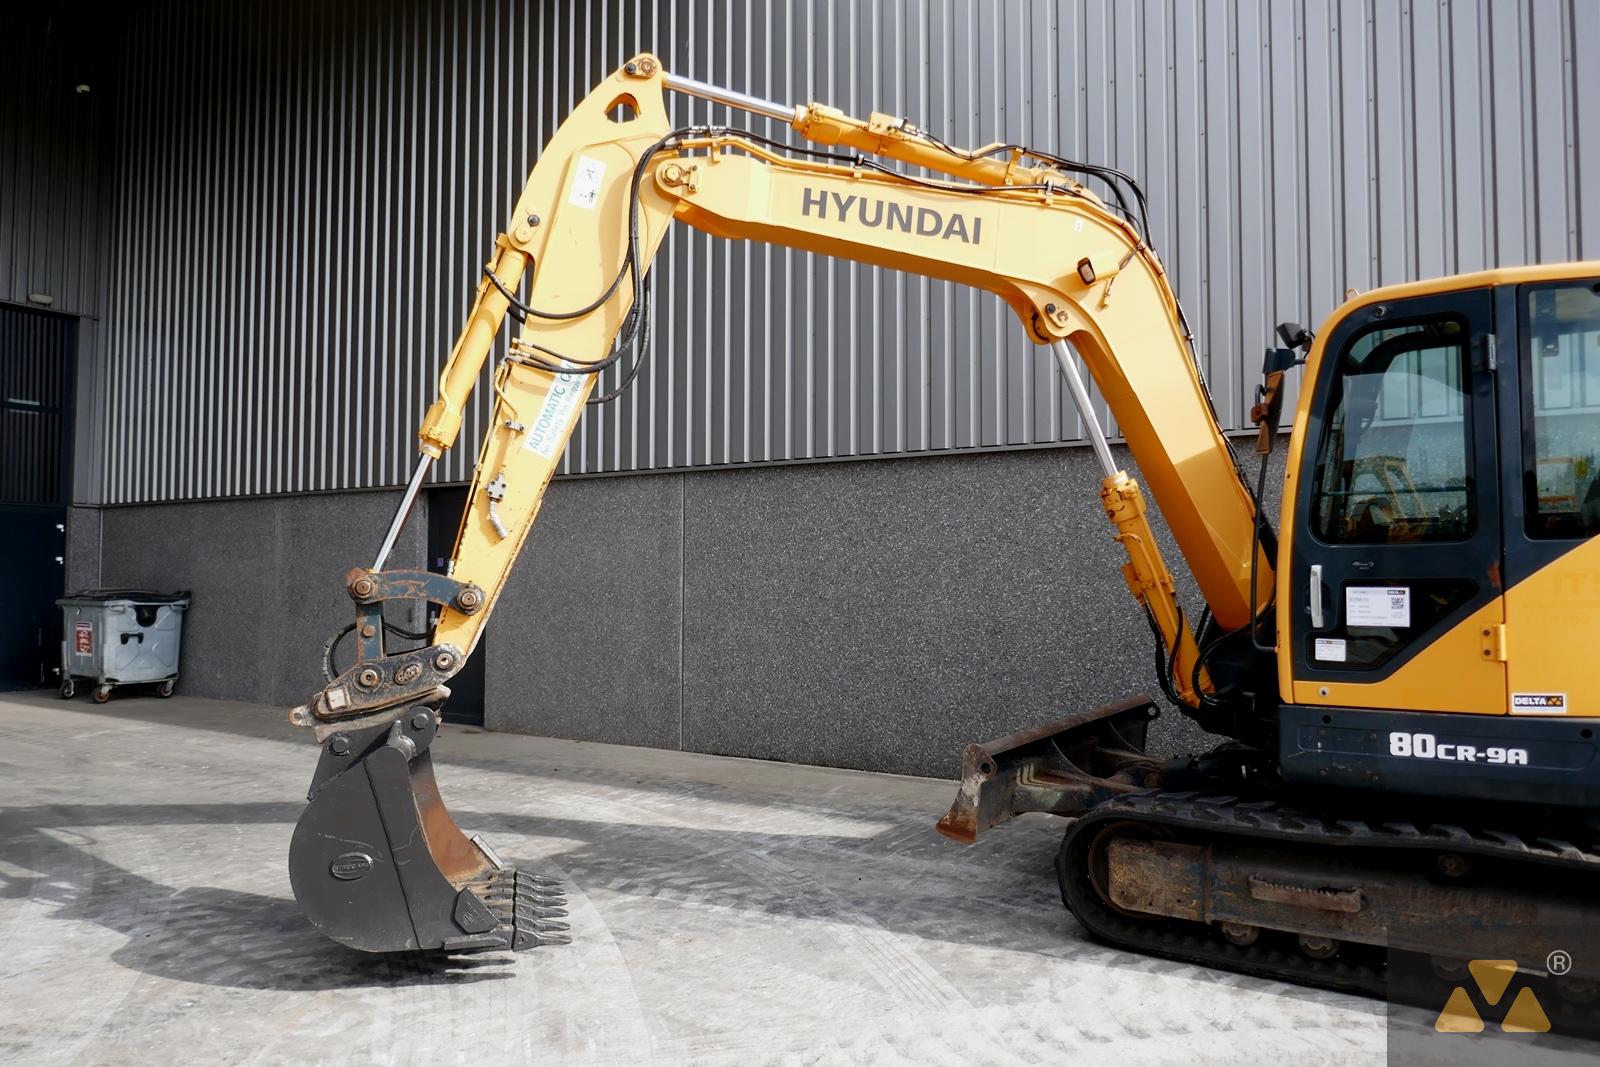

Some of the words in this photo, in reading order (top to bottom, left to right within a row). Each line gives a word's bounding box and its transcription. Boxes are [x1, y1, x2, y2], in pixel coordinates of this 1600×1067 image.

[802, 187, 982, 245] HYUNDAI
[528, 384, 567, 450] AUTOMATIC
[1513, 696, 1547, 706] DELTA
[1389, 732, 1528, 765] 80CR-9A
